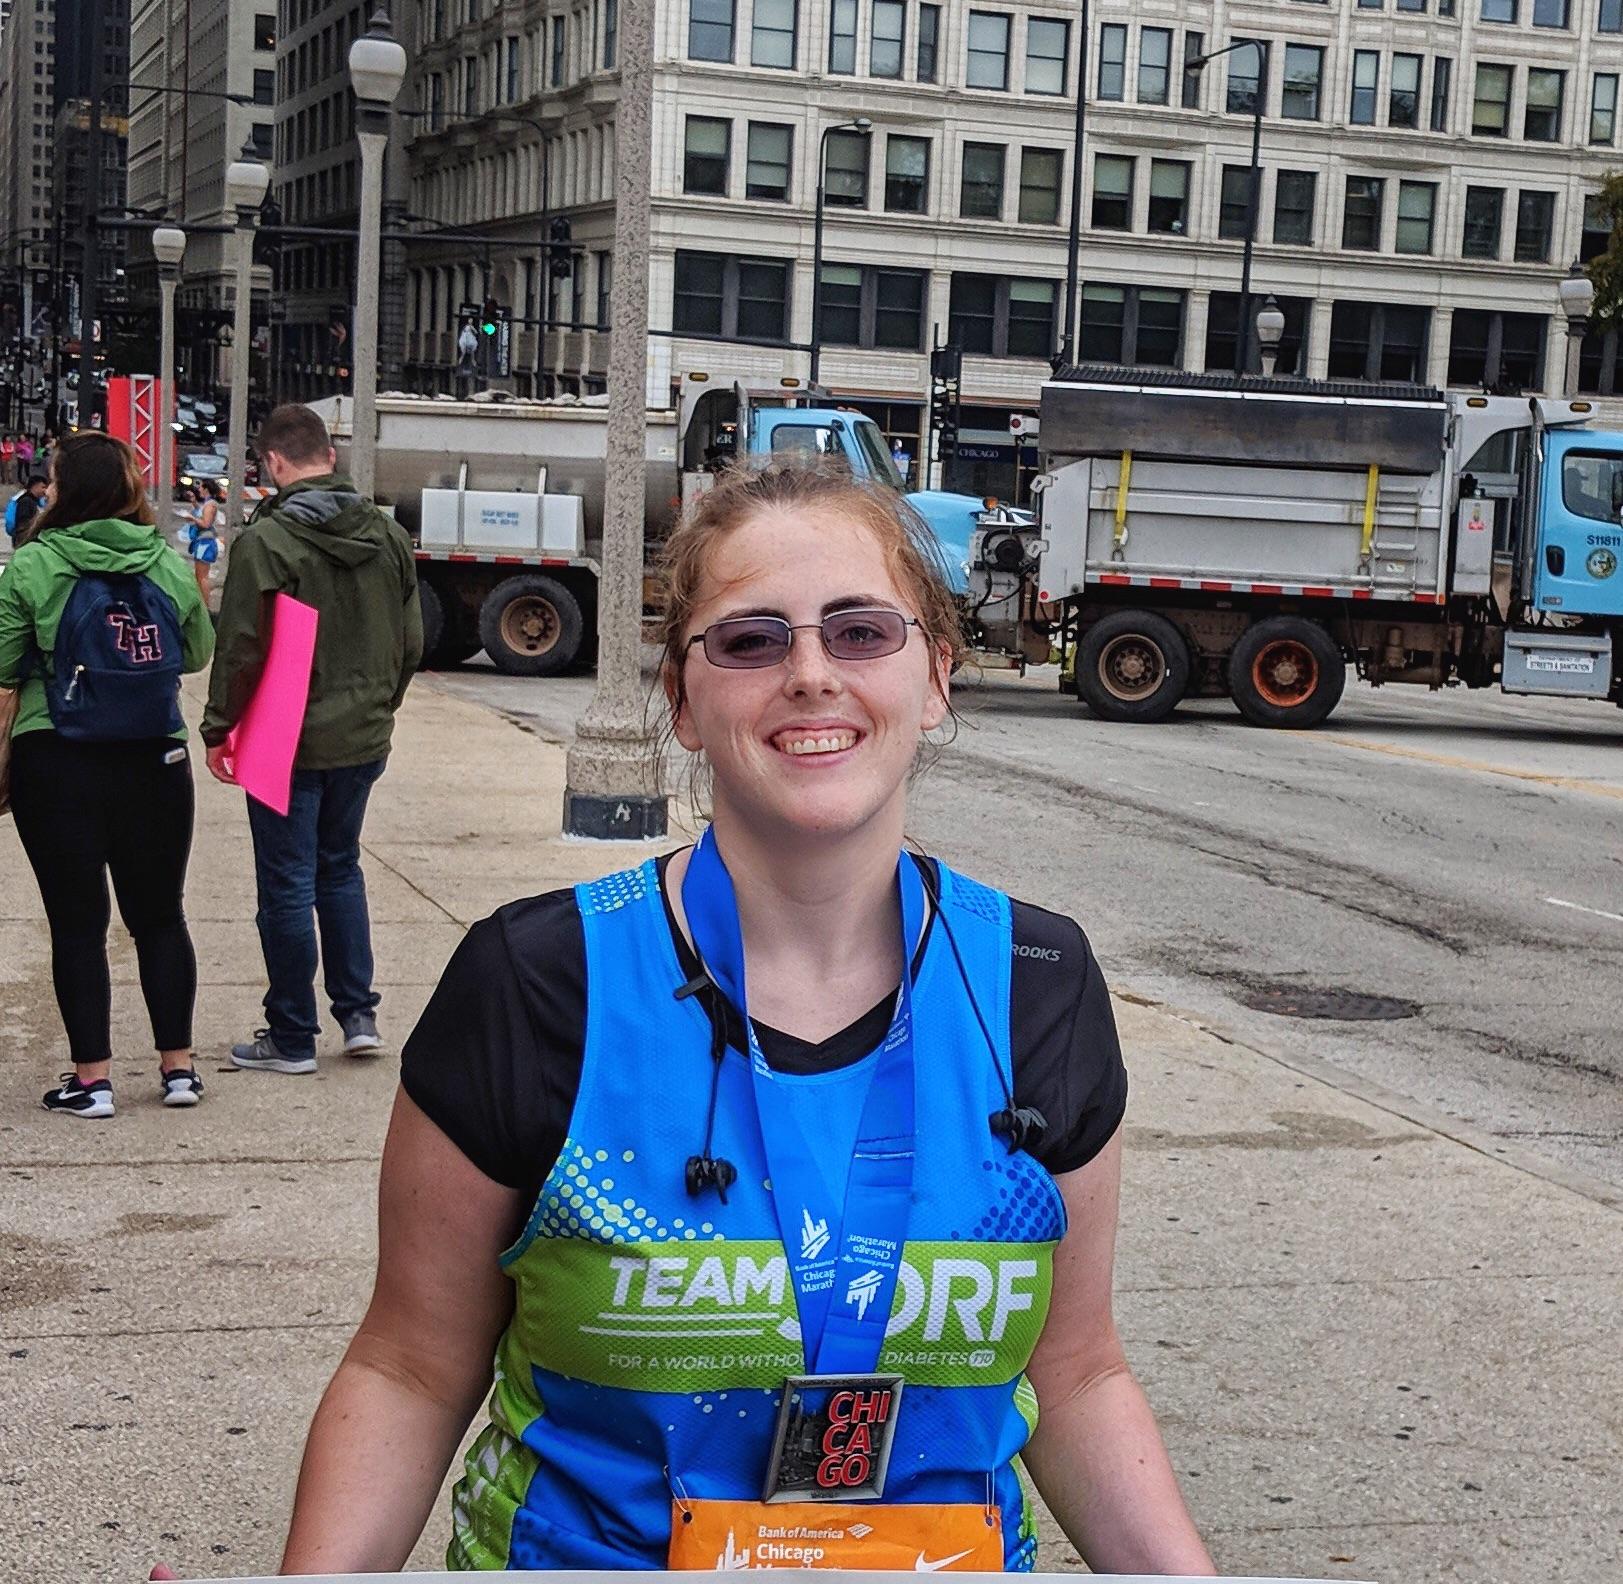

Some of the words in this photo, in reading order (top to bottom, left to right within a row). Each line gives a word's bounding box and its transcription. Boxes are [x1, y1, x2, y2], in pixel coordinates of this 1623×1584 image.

[959, 448, 999, 458] CHICAGO
[1011, 943, 1062, 962] ROOKS
[609, 1256, 788, 1307] TEAM
[803, 1269, 836, 1282] Chicag
[608, 1353, 642, 1369] FOR
[649, 1356, 659, 1368] A
[666, 1353, 736, 1371] WORLD
[738, 1352, 805, 1368] WITHO
[885, 1351, 968, 1367] DIABETES
[828, 1391, 892, 1425] CHI
[822, 1423, 872, 1456] CA
[816, 1454, 871, 1488] GO
[758, 1525, 788, 1538] Bank
[787, 1526, 800, 1539] of
[799, 1527, 845, 1539] America
[756, 1543, 824, 1563] Chicago
